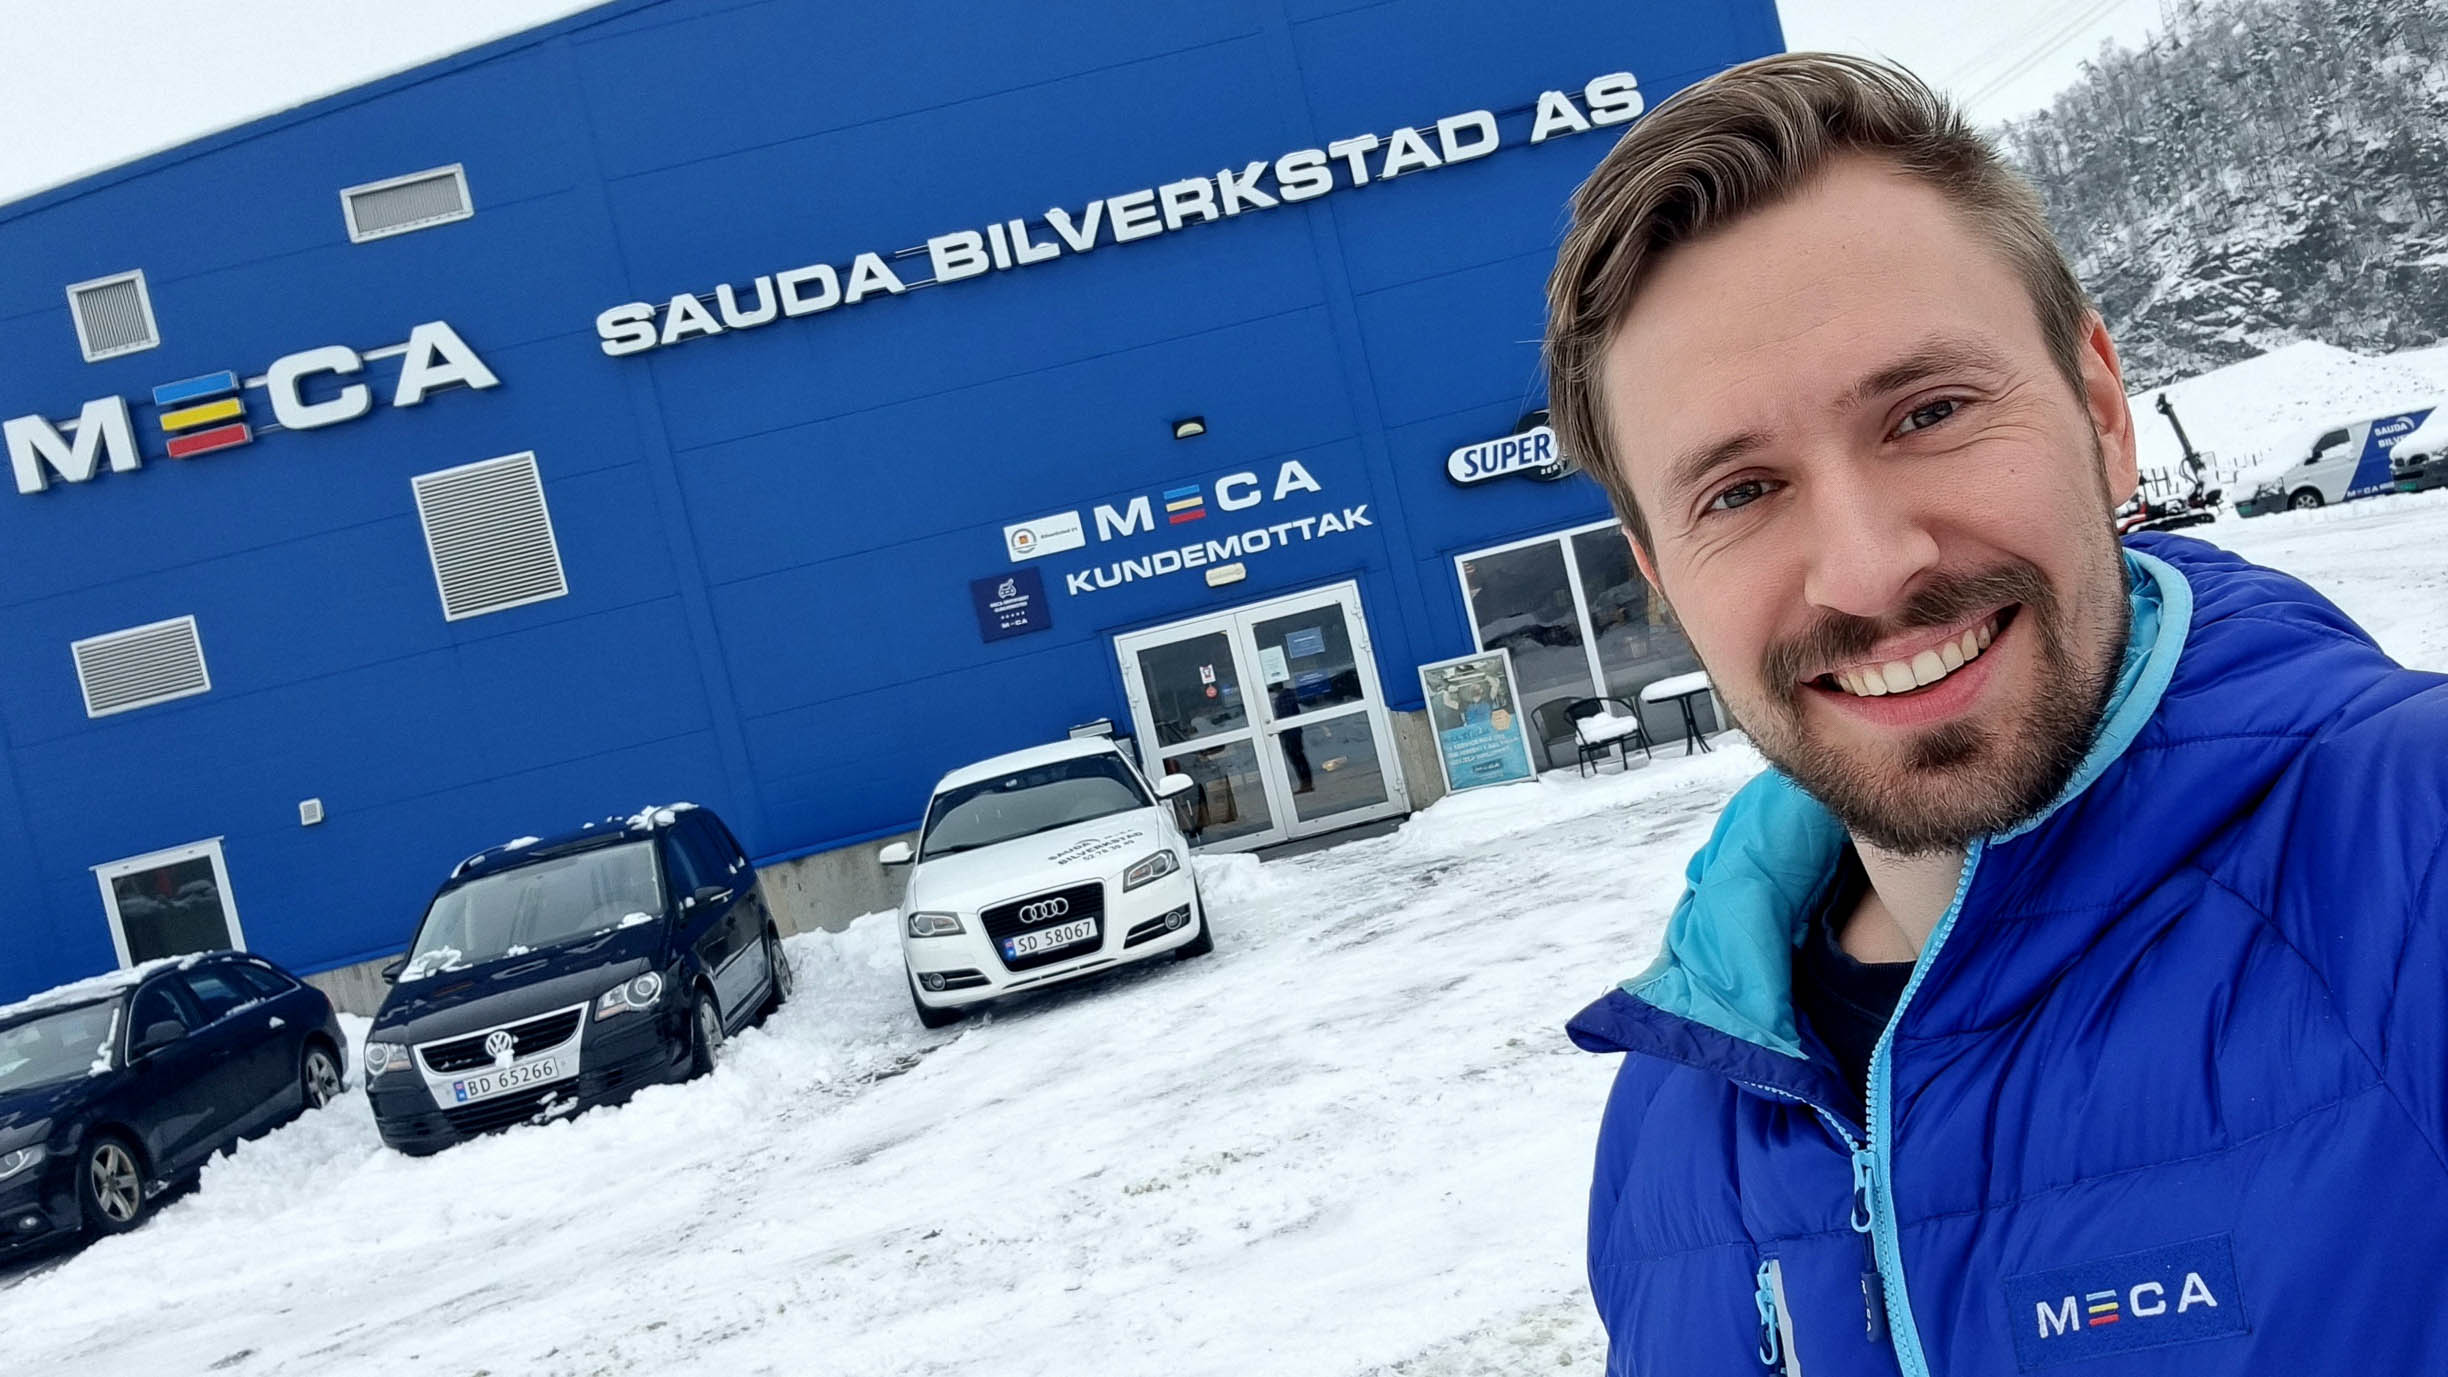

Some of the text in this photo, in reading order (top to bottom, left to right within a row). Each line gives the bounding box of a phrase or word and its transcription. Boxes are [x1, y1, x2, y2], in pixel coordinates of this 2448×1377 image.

[596, 72, 1645, 357] SAUDA BILVERKSTAD AS
[2374, 422, 2408, 437] SAUDA
[1463, 433, 1551, 478] SUPER
[1066, 504, 1373, 596] KUNDEMOTTAK
[1048, 842, 1091, 861] SAUDA
[1058, 831, 1143, 865] BILVERKSTAD
[1018, 921, 1091, 953] SD 58067
[467, 1060, 553, 1097] BD 65266
